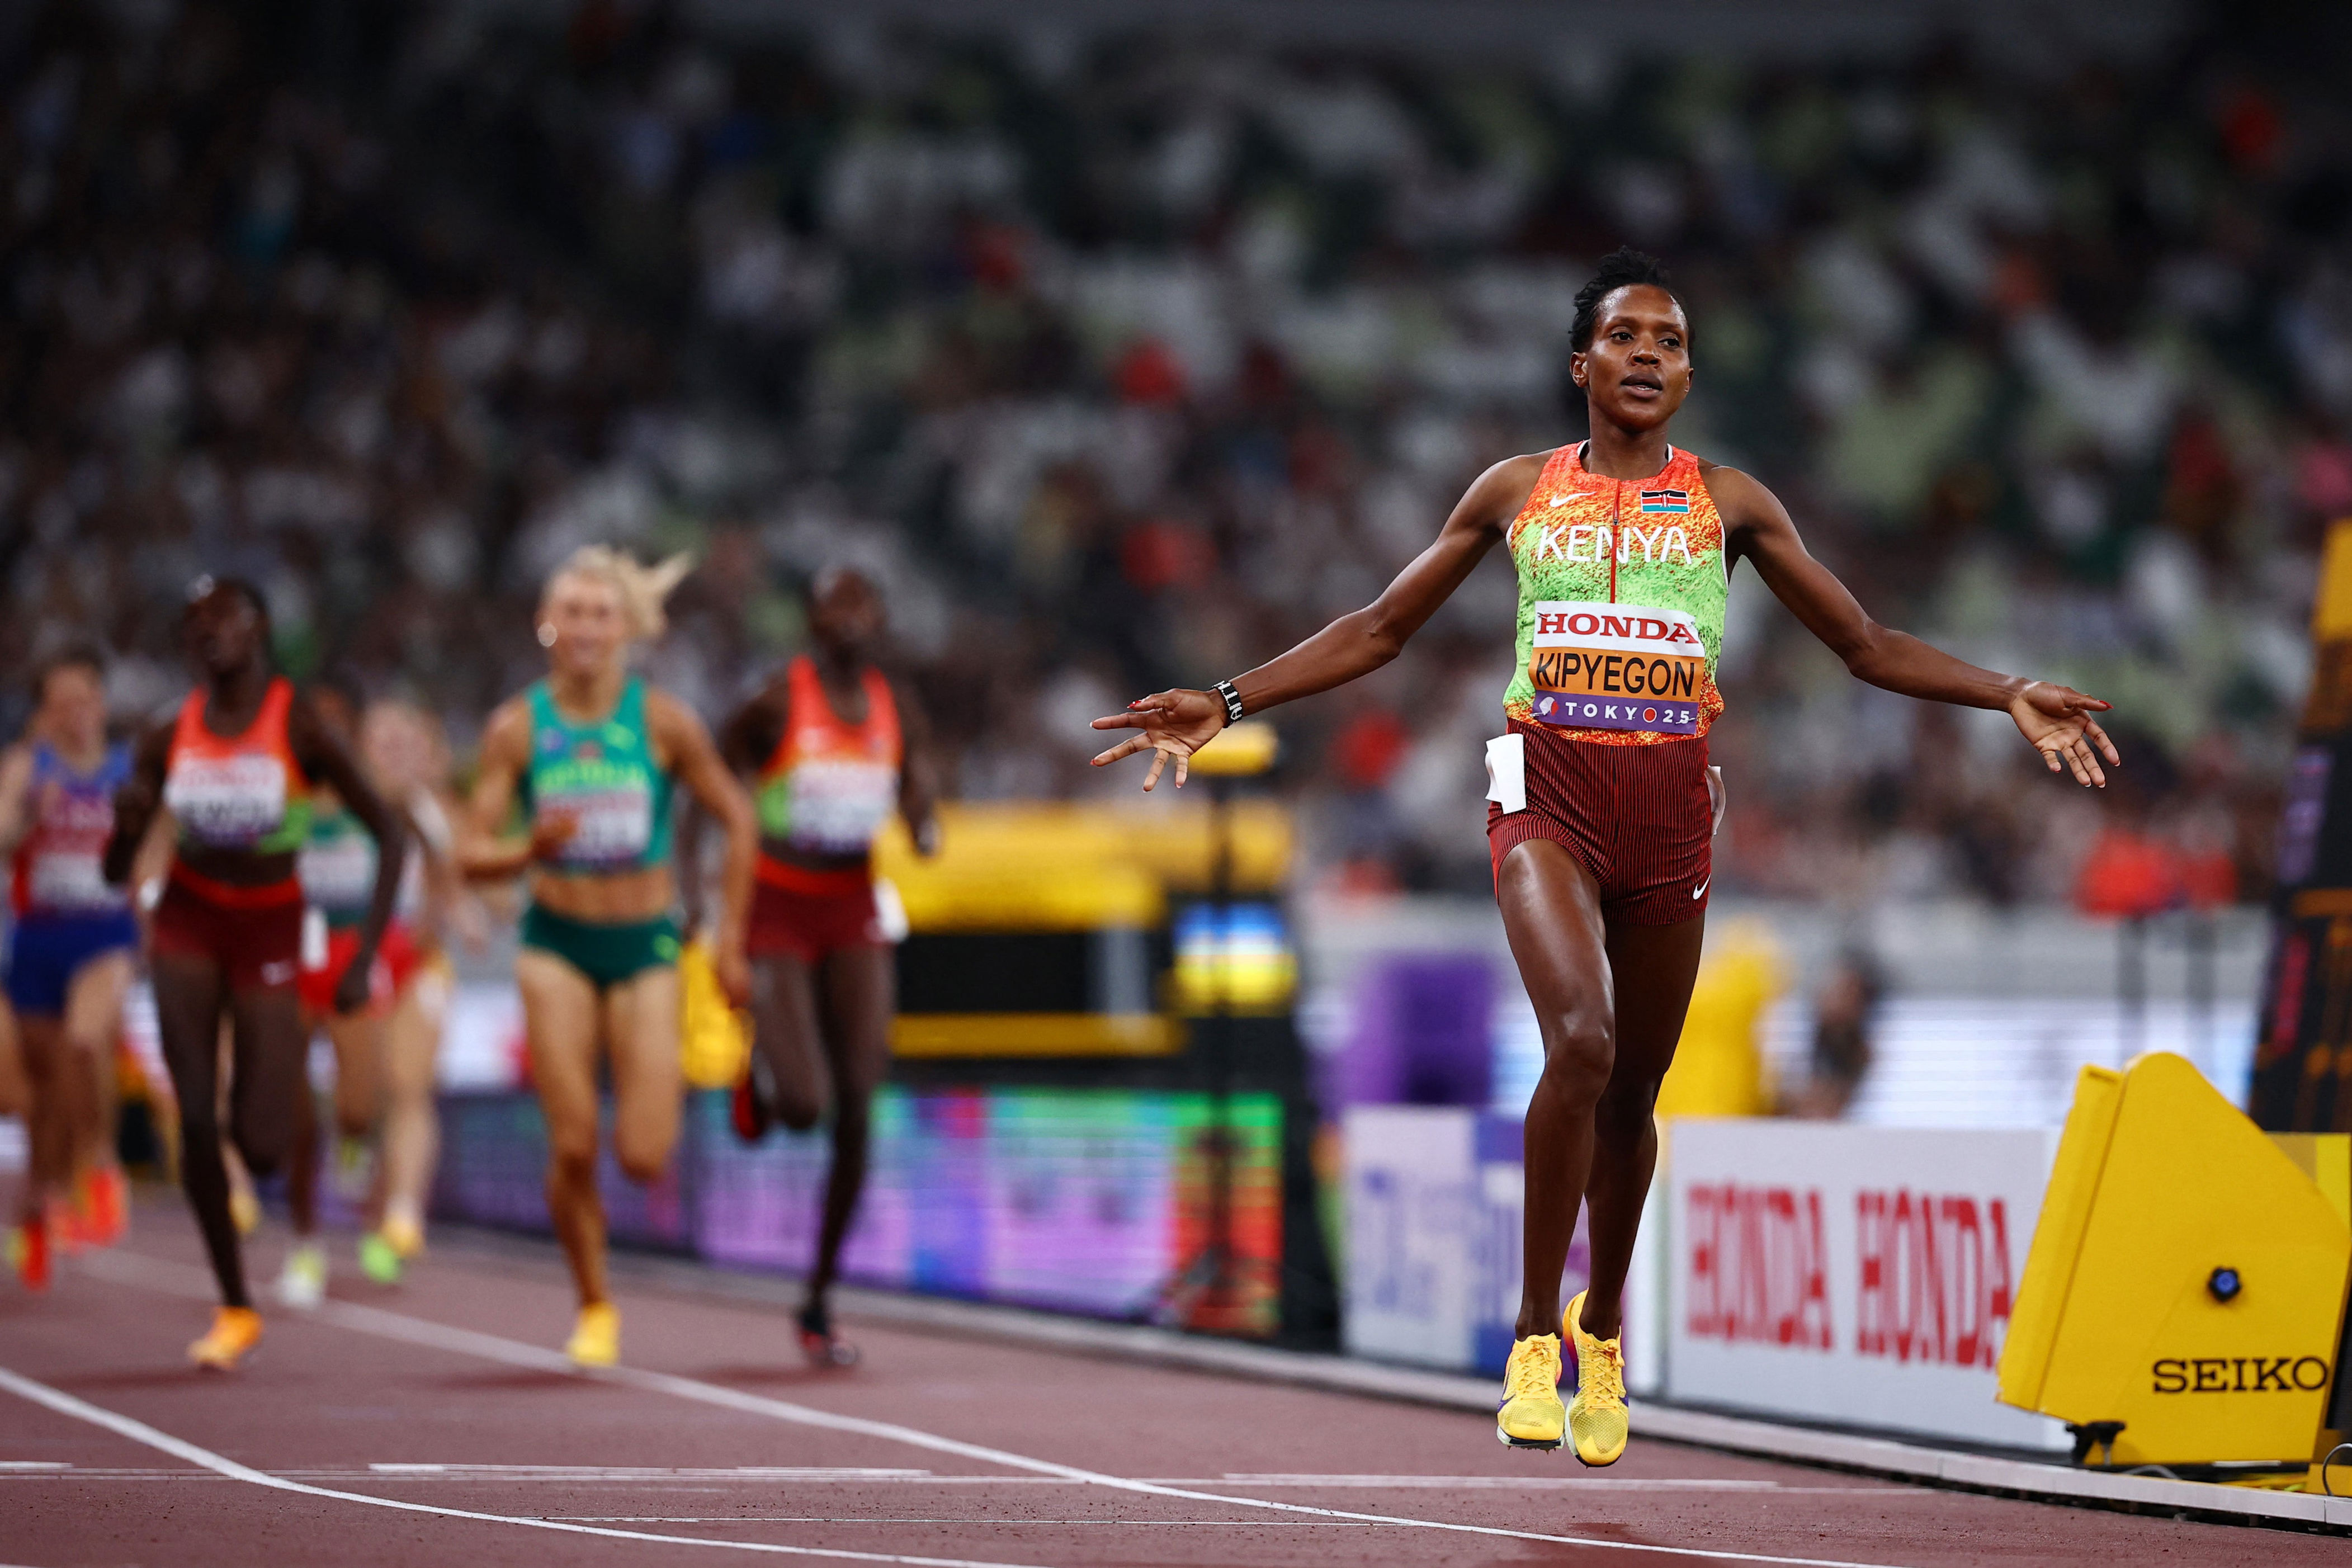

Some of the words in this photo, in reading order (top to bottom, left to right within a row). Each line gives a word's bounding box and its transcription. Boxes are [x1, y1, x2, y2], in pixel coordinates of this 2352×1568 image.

[1537, 525, 1692, 564] KENYA
[1537, 613, 1698, 644] HONDA
[1536, 653, 1694, 697] KIPYEGON
[1212, 680, 1243, 721] AITH
[1687, 1182, 1832, 1350] HONDA
[1856, 1189, 2011, 1369] HONDA
[2153, 1357, 2328, 1392] SEIKO
